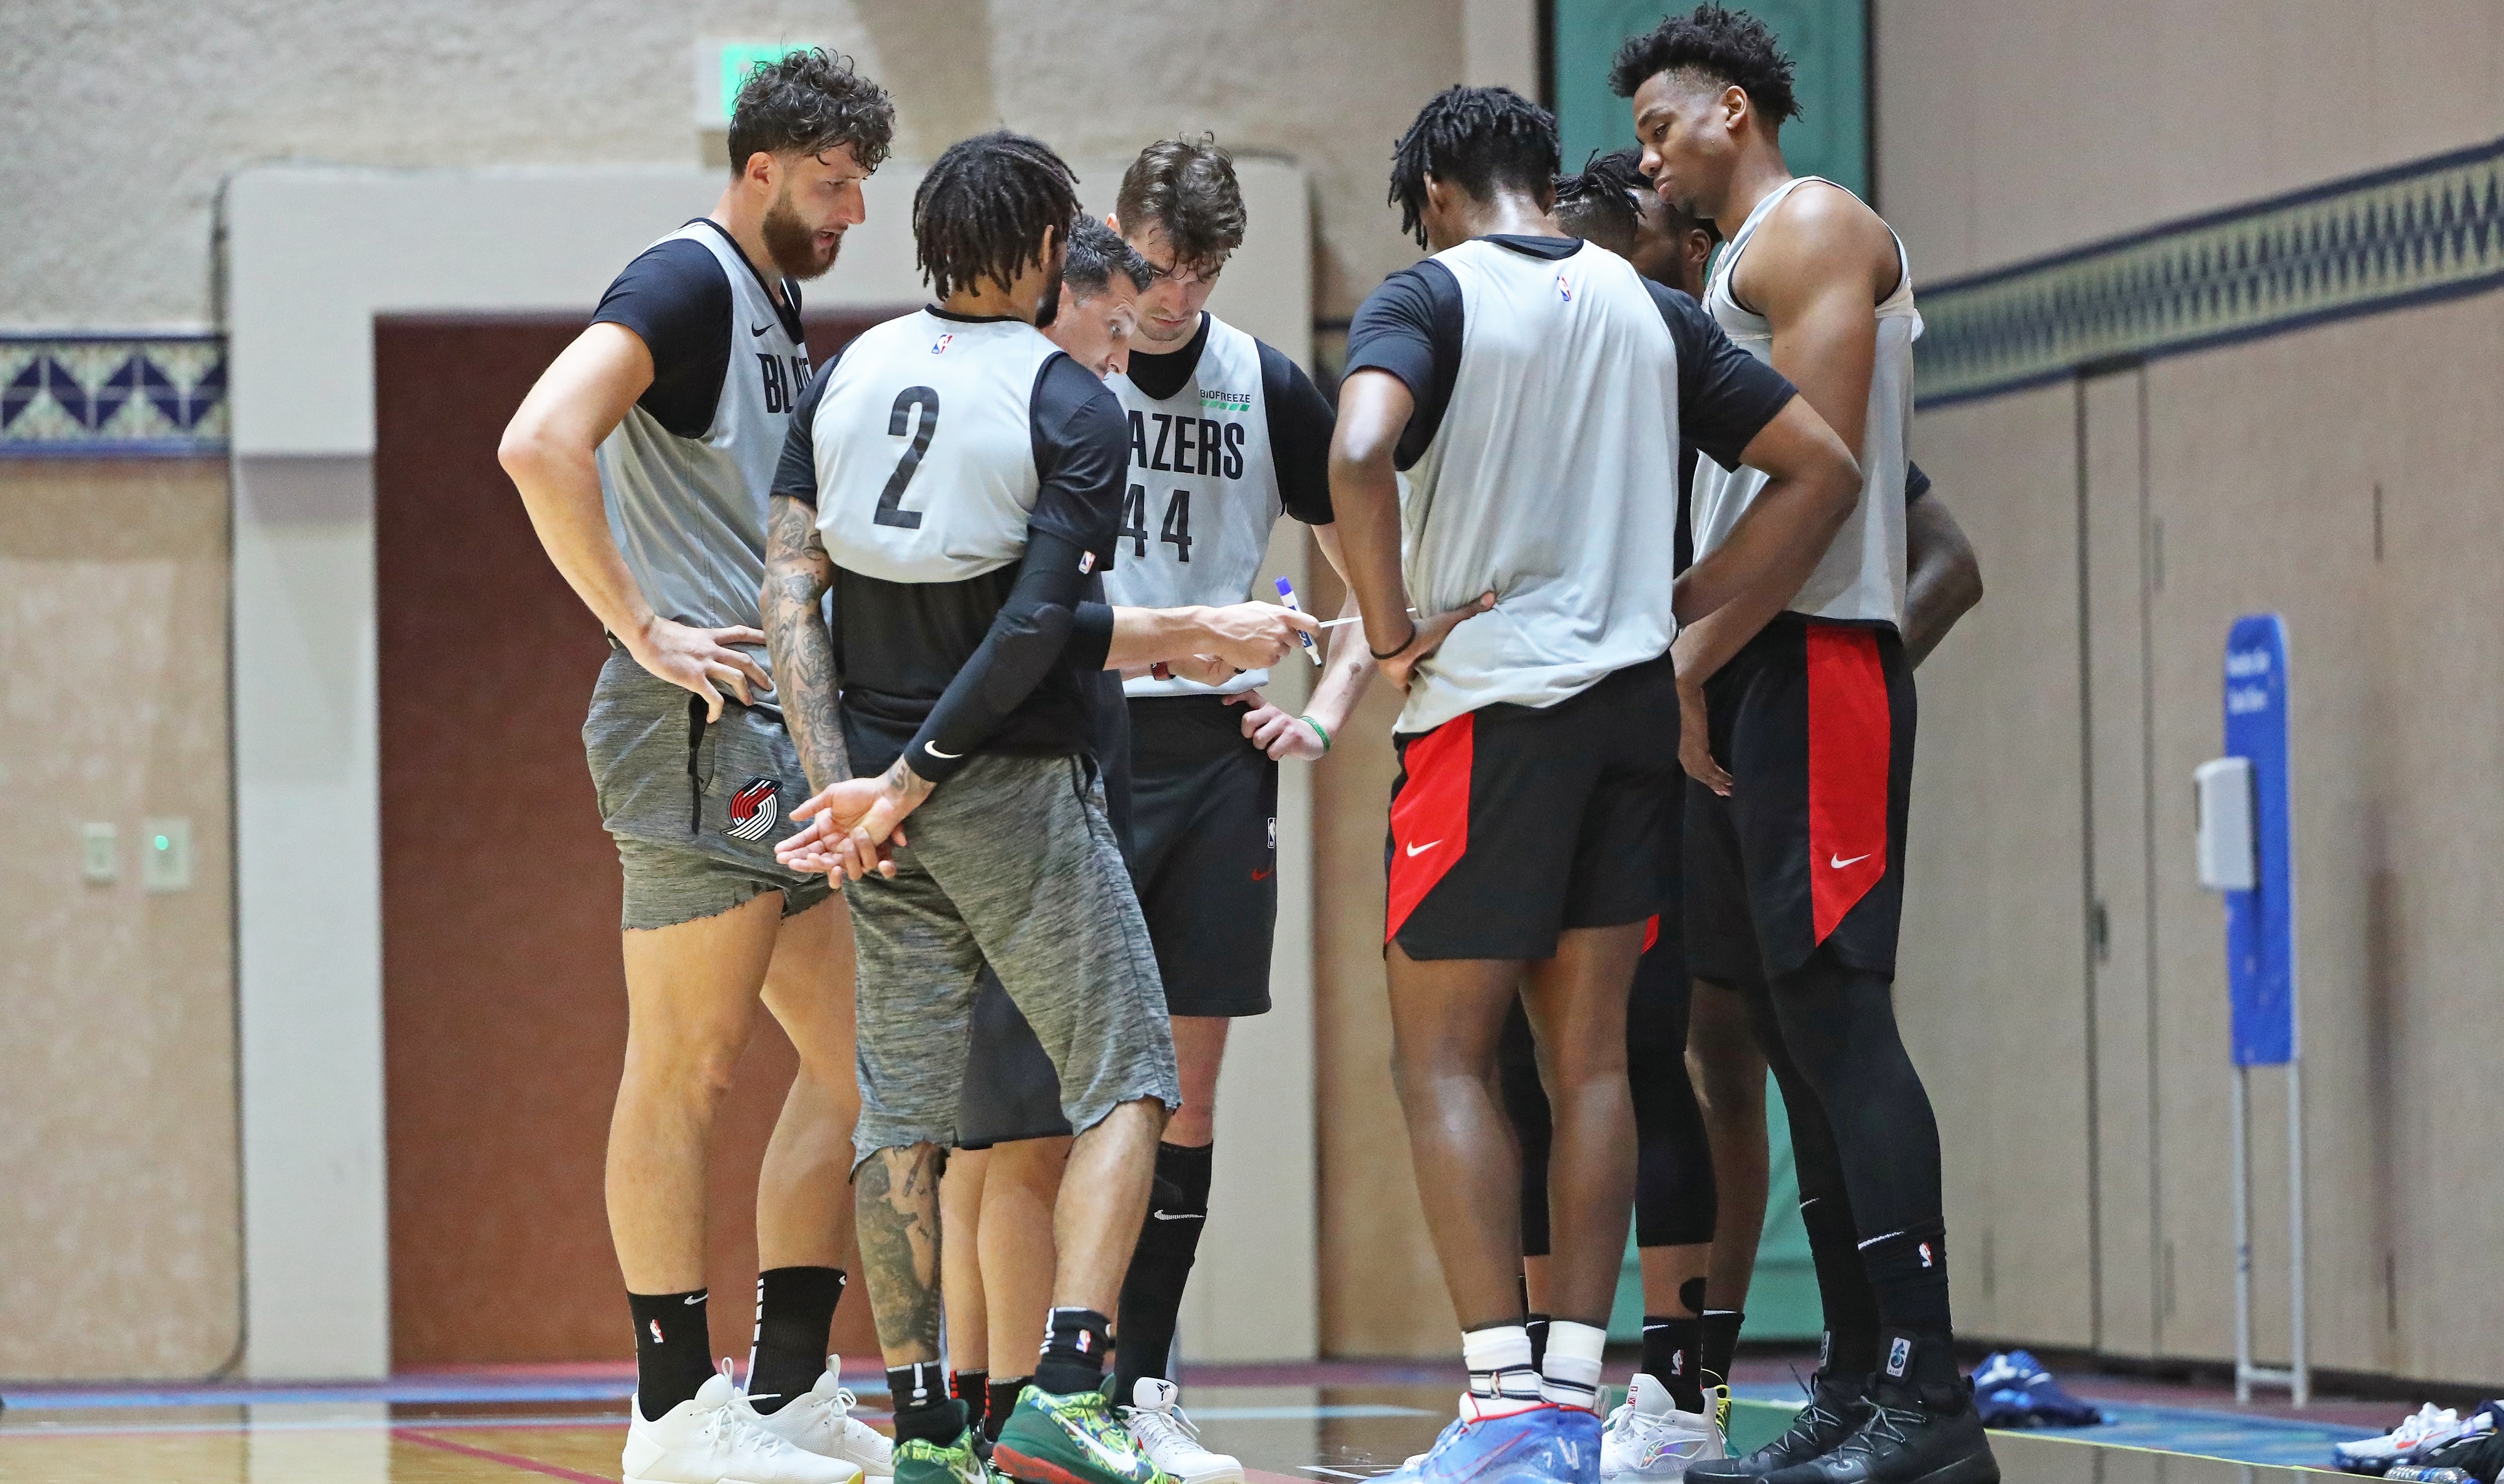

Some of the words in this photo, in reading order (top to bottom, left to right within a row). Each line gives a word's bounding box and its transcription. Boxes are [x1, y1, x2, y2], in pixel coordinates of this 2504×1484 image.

[1200, 389, 1251, 403] BIOFREEZE
[873, 386, 939, 529] 2
[1119, 484, 1192, 562] 44
